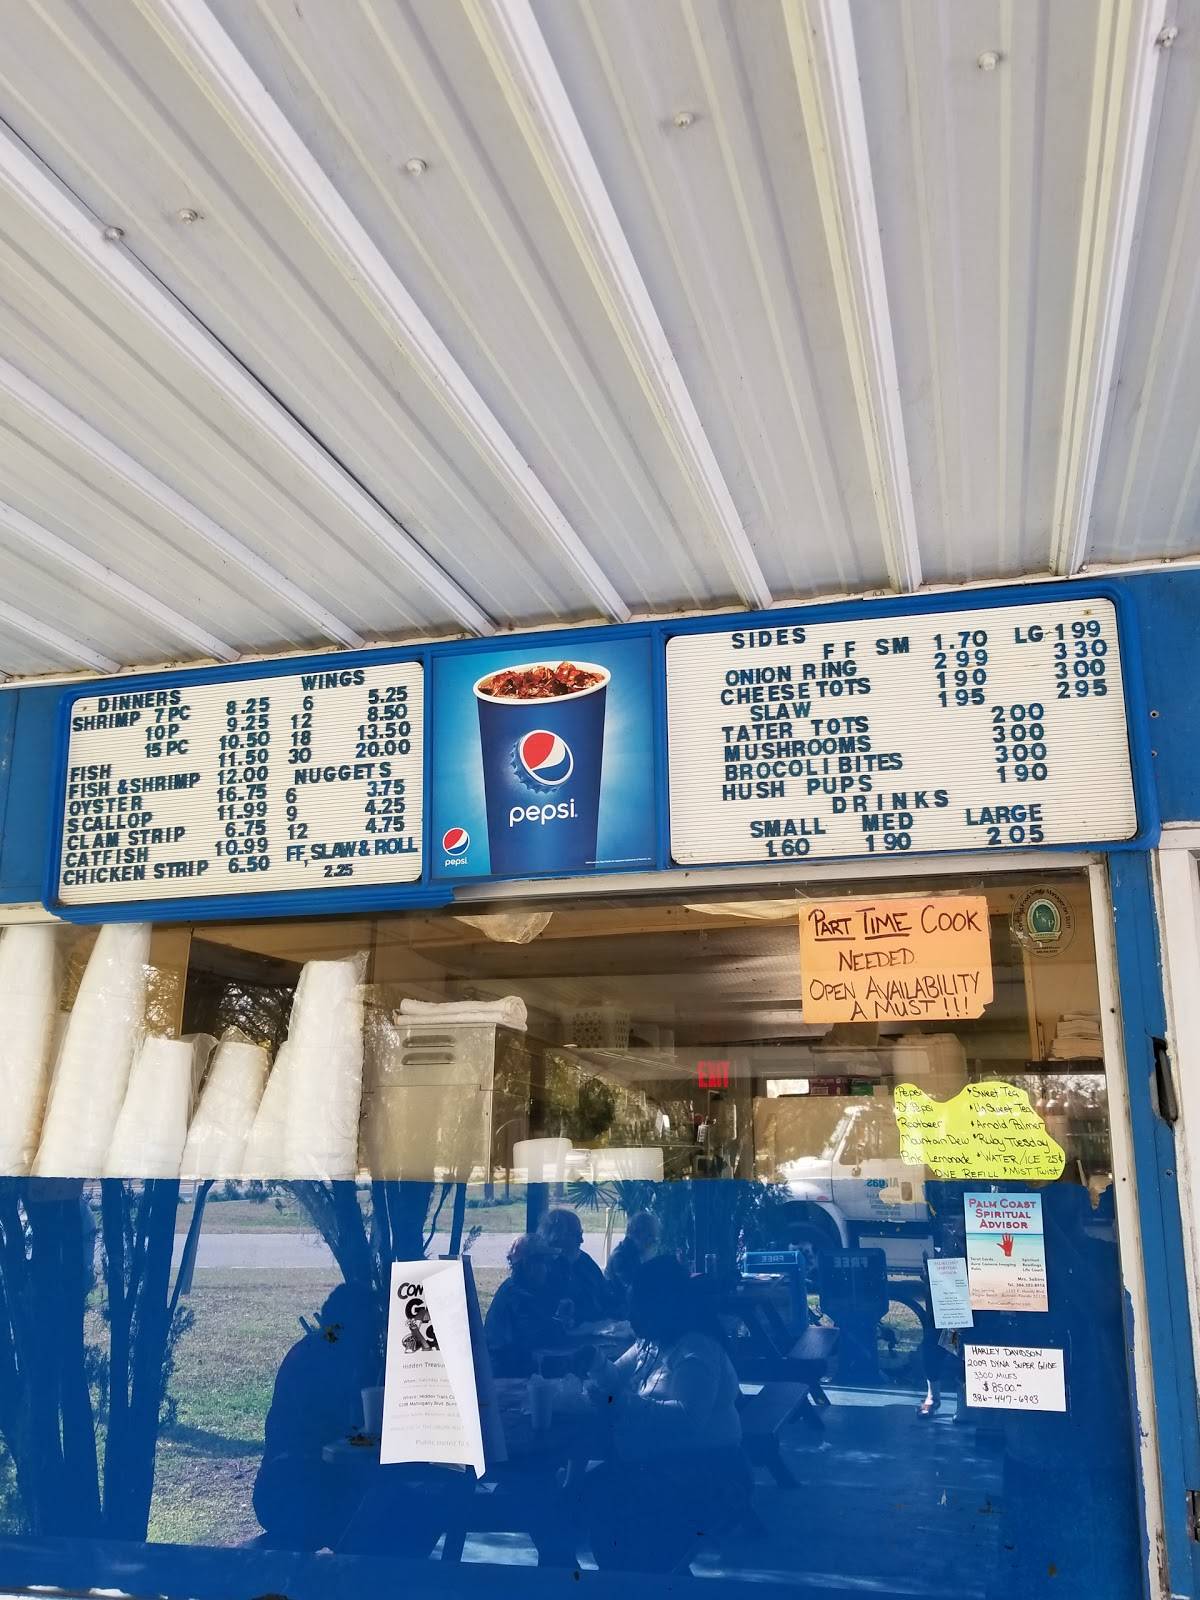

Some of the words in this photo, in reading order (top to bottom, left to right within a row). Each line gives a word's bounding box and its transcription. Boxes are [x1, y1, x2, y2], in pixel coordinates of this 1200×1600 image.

[732, 627, 805, 649] SIDES
[876, 636, 909, 655] SM
[301, 670, 365, 691] WINGS
[725, 665, 791, 686] ONION
[803, 660, 857, 680] RING
[98, 690, 181, 712] DINNERS
[303, 696, 314, 711] 6
[368, 686, 408, 704] 5.25
[73, 711, 141, 732] SHRIMP
[226, 697, 269, 715] 8.25
[227, 714, 269, 732] 9.25
[291, 713, 312, 729] 12
[367, 704, 407, 722] 8.50
[750, 701, 811, 722] SLAW
[220, 731, 270, 750] 10.50
[291, 730, 311, 746] 18
[358, 721, 411, 740] 13.50
[722, 722, 793, 743] TATER
[811, 716, 869, 736] TOTS
[288, 748, 311, 764] 30
[356, 739, 411, 758] 20.00
[725, 735, 871, 762] MUSHROOMS
[71, 764, 112, 782] FISH
[219, 749, 269, 767] 11.50
[294, 762, 392, 785] NUGGETS
[725, 759, 828, 781] BROCOLI
[839, 753, 903, 774] BITES
[69, 781, 110, 799] FISH
[217, 766, 268, 785] 12.00
[286, 788, 296, 803] 6
[367, 779, 405, 797] 3.75
[723, 781, 784, 800] HUSH
[807, 775, 872, 795] PUPS
[70, 796, 142, 816] OYSTER
[217, 784, 267, 802] 16.75
[287, 806, 297, 821] 9
[365, 797, 405, 815] 4.25
[832, 790, 948, 814] DRINKS
[68, 812, 152, 833] SCALLOP
[217, 801, 267, 820] 11.99
[509, 799, 575, 827] pepsi
[750, 818, 826, 838] SMALL
[862, 812, 913, 832] MED
[966, 804, 1043, 826] LARGE
[68, 832, 119, 850] CLAM
[129, 827, 185, 845] STRIP
[225, 820, 266, 837] 6.75
[288, 823, 308, 839] 12
[365, 816, 405, 833] 4.75
[66, 847, 148, 867] CATFISH
[215, 837, 268, 856] 10.99
[375, 837, 418, 855] ROLL
[63, 865, 145, 885] CHICKEN
[154, 860, 208, 879] STRIP
[229, 855, 270, 873] 6.50
[324, 863, 354, 878] 2.25
[445, 857, 467, 867] pepsi
[808, 909, 851, 936] PART
[856, 907, 912, 934] TIME
[921, 905, 982, 933] COOK
[839, 948, 914, 972] NEEDED
[809, 978, 856, 1001] OPEN
[865, 971, 979, 1001] AVAILABILITY
[850, 1003, 867, 1021] A
[697, 1060, 730, 1088] EXIT
[972, 1087, 998, 1098] Sweet
[1000, 1087, 1019, 1098] Tea
[1016, 1103, 1033, 1113] Tea
[977, 1120, 1007, 1129] Arnold
[1013, 1119, 1044, 1130] Palmer
[978, 1135, 1006, 1152] Ruby
[1005, 1137, 1050, 1153] Tuesday
[927, 1153, 974, 1165] Lemonade
[934, 1170, 956, 1178] ONE
[964, 1170, 998, 1178] REFILL
[968, 1198, 996, 1208] PALM
[1000, 1199, 1036, 1208] COAST
[975, 1208, 1031, 1219] SPIRITUAL
[980, 1219, 1028, 1229] ADVISOR
[968, 1359, 987, 1367] 2009
[1013, 1361, 1035, 1369] SUPER
[972, 1347, 1000, 1355] HARLEY
[1004, 1349, 1042, 1357] DAVIDSON
